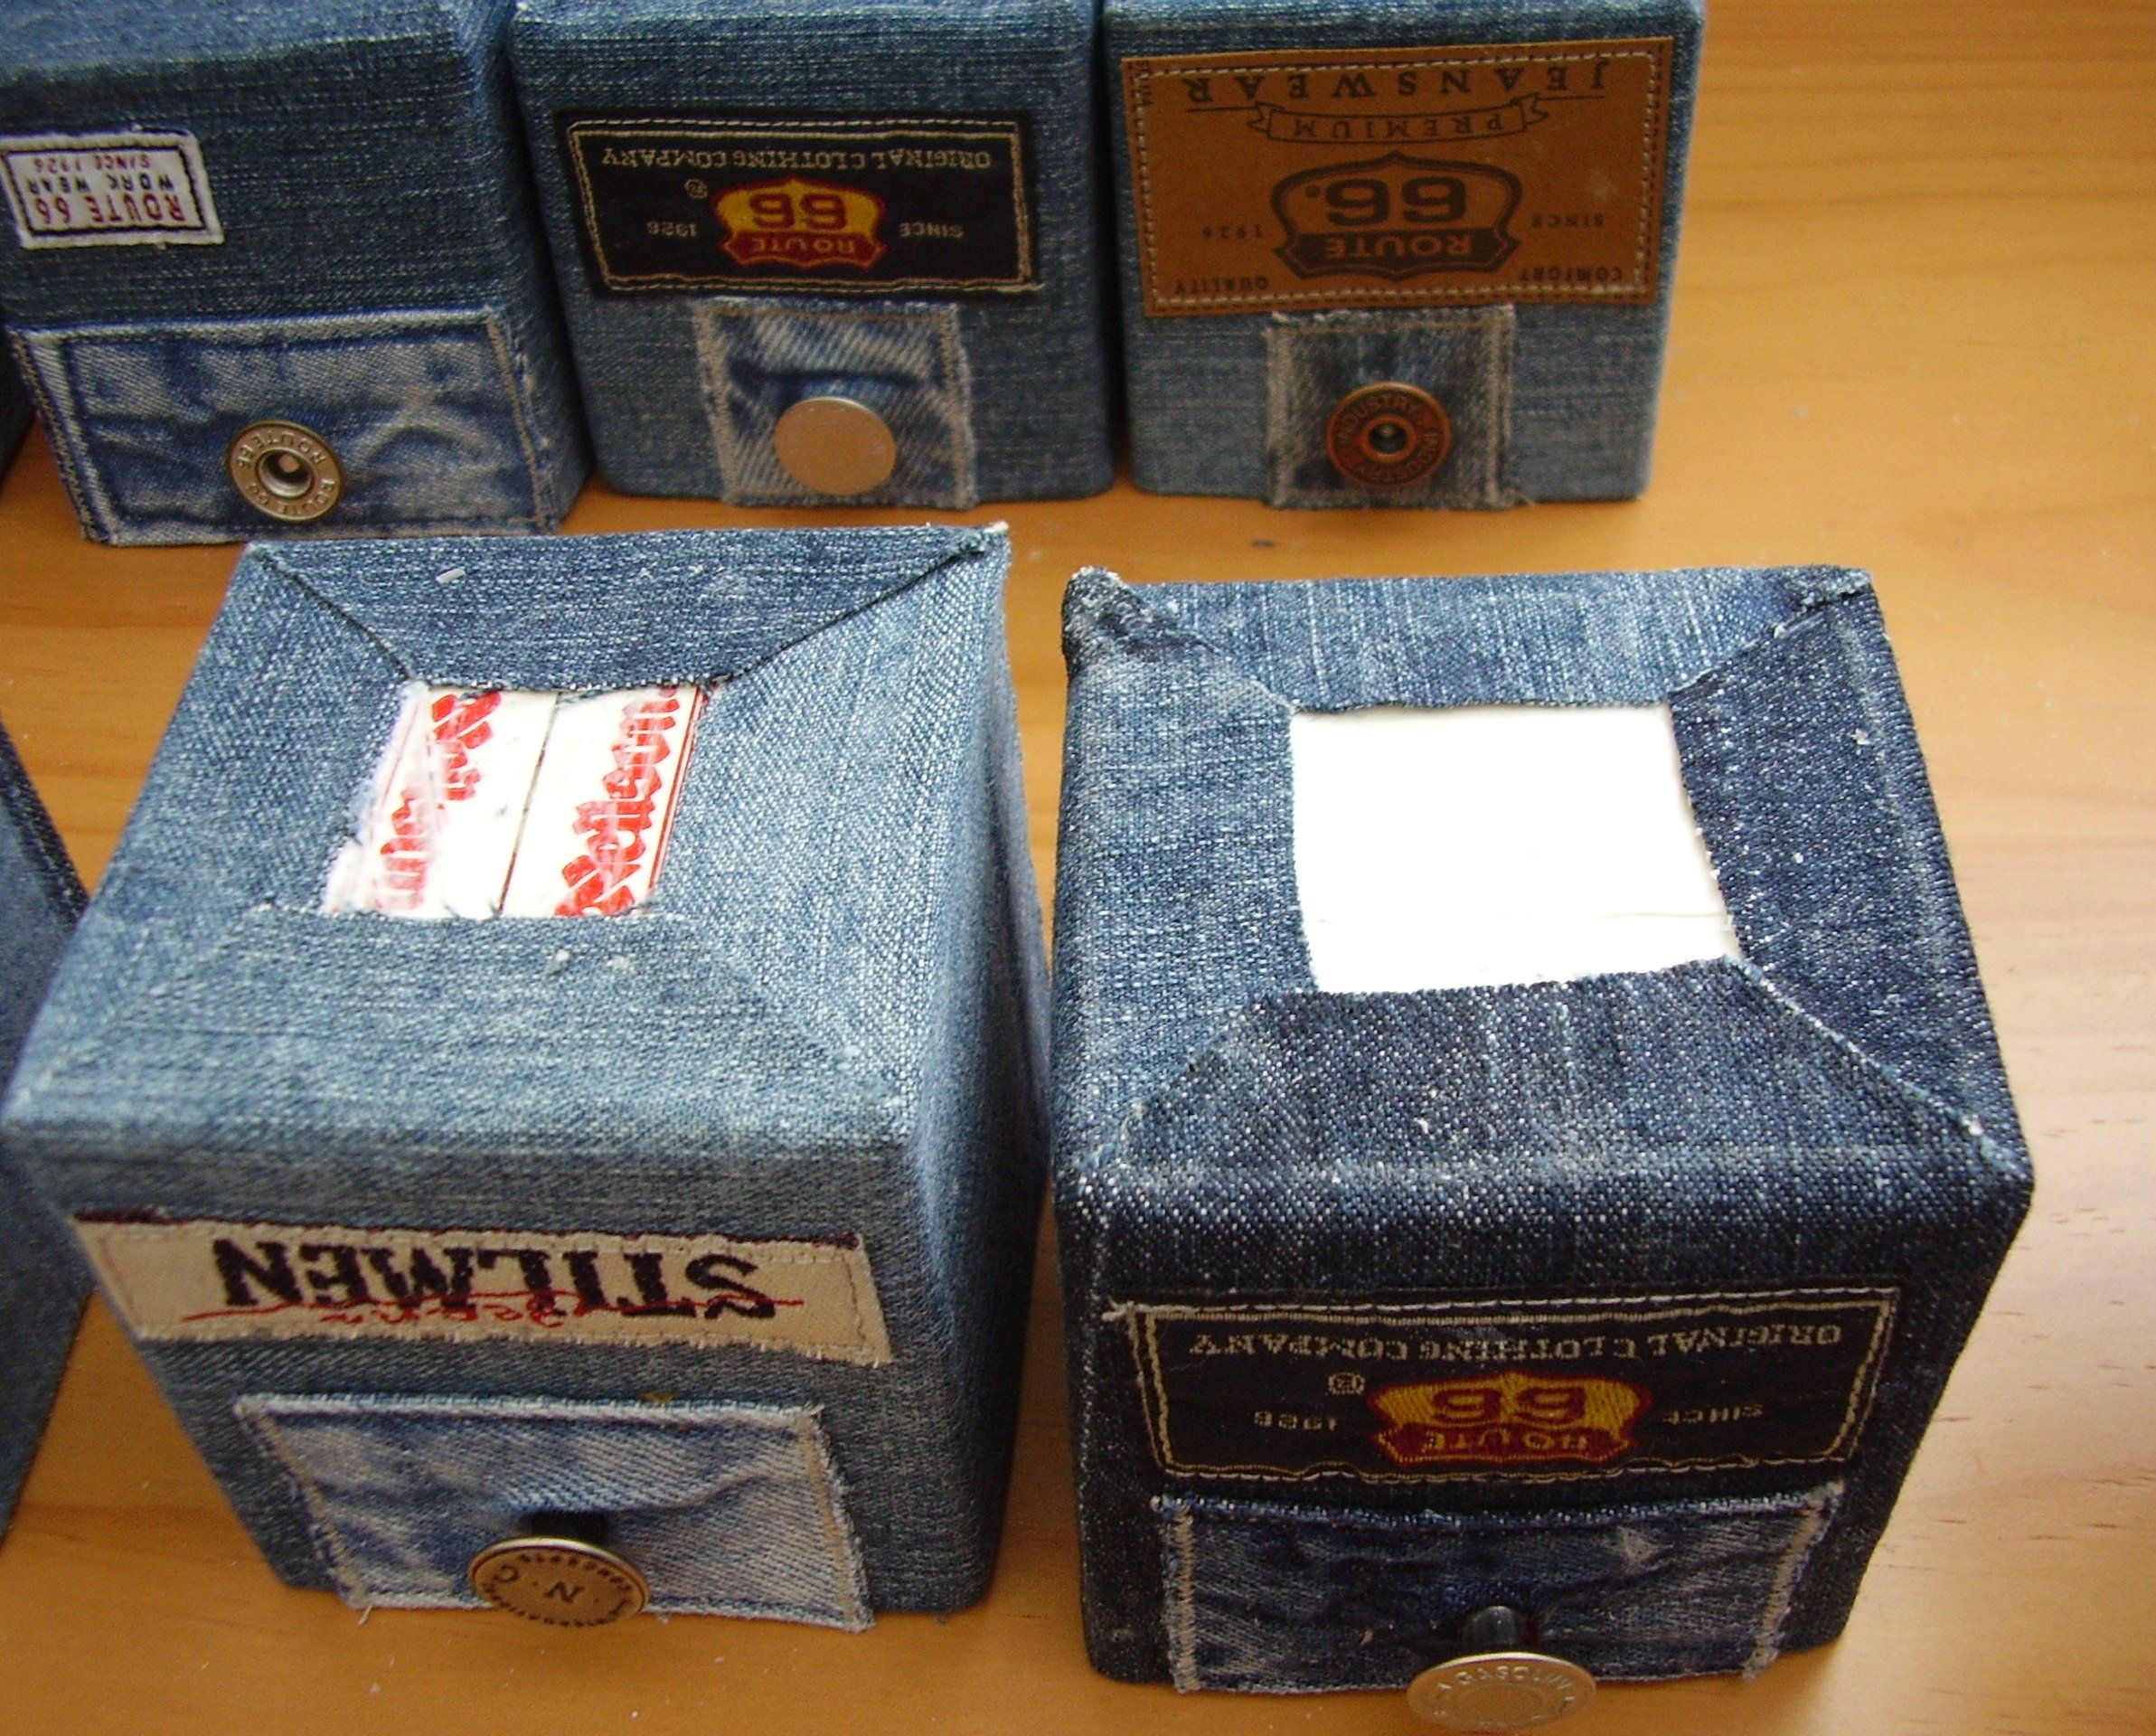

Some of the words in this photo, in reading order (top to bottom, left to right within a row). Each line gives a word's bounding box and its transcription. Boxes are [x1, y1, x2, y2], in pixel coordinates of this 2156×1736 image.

[1182, 60, 1609, 103] JEANSWEAR
[1294, 116, 1502, 137] PREMIUM
[94, 154, 151, 169] SINCE
[602, 147, 727, 169] COMPANY
[733, 149, 865, 170] CLOTHING
[871, 147, 993, 170] ORIGINAL
[28, 175, 90, 195] WEAR
[107, 172, 174, 192] WORK
[34, 196, 72, 225] 66
[84, 193, 186, 223] ROUTE
[748, 192, 848, 231] 66
[899, 222, 965, 239] SINCE
[1532, 213, 1605, 227] SINCE
[752, 237, 855, 254] ROUTE
[1324, 234, 1473, 260] ROUTE
[1175, 277, 1269, 294] QUALITY
[212, 1237, 777, 1320] STILMEN
[1189, 1334, 1408, 1360] COMPANY
[1419, 1336, 1635, 1361] CLOTHING
[1647, 1323, 1842, 1356] ORIGINAL
[1432, 1387, 1586, 1426] 66
[1662, 1403, 1763, 1426] SINCE
[1424, 1428, 1587, 1450] ROUTE
